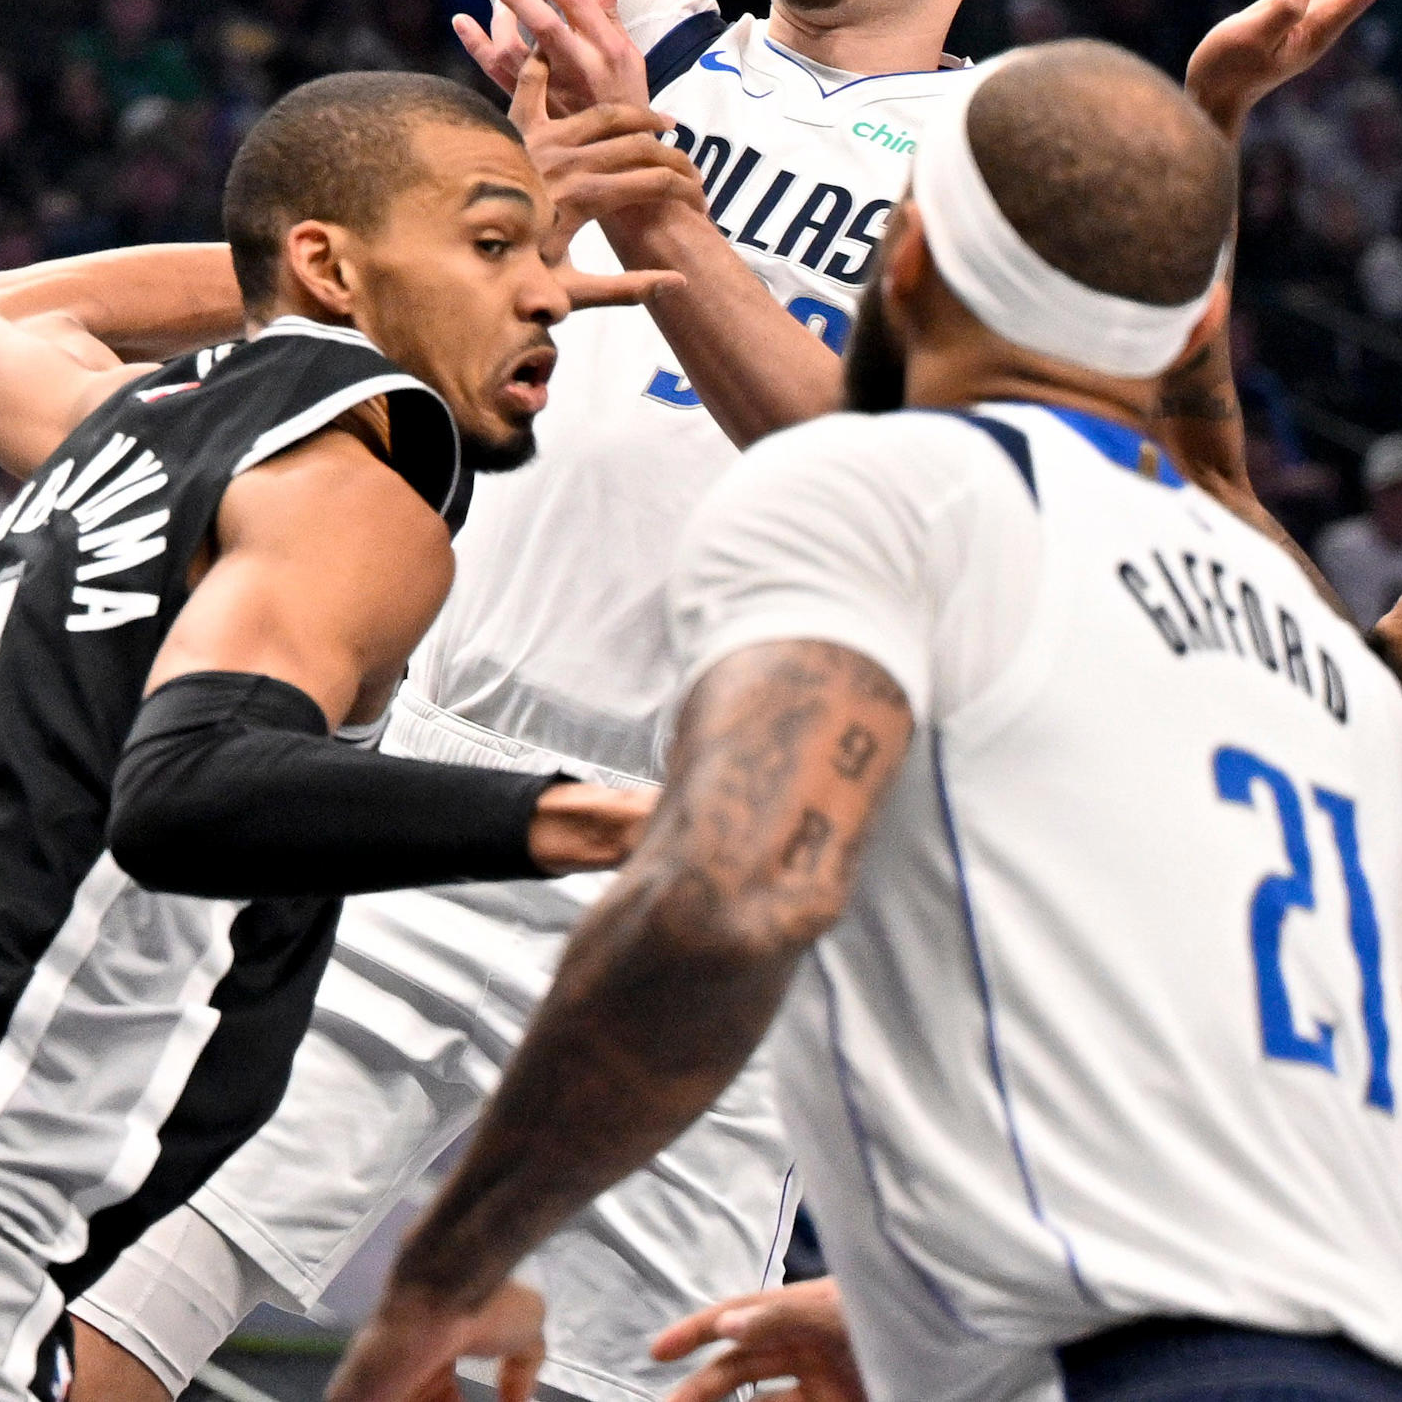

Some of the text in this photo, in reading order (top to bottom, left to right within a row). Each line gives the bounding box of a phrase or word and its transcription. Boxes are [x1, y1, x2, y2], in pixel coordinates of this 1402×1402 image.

[654, 122, 900, 286] ALLAS
[1116, 548, 1350, 727] GAFFORD
[1211, 742, 1396, 1119] 21
